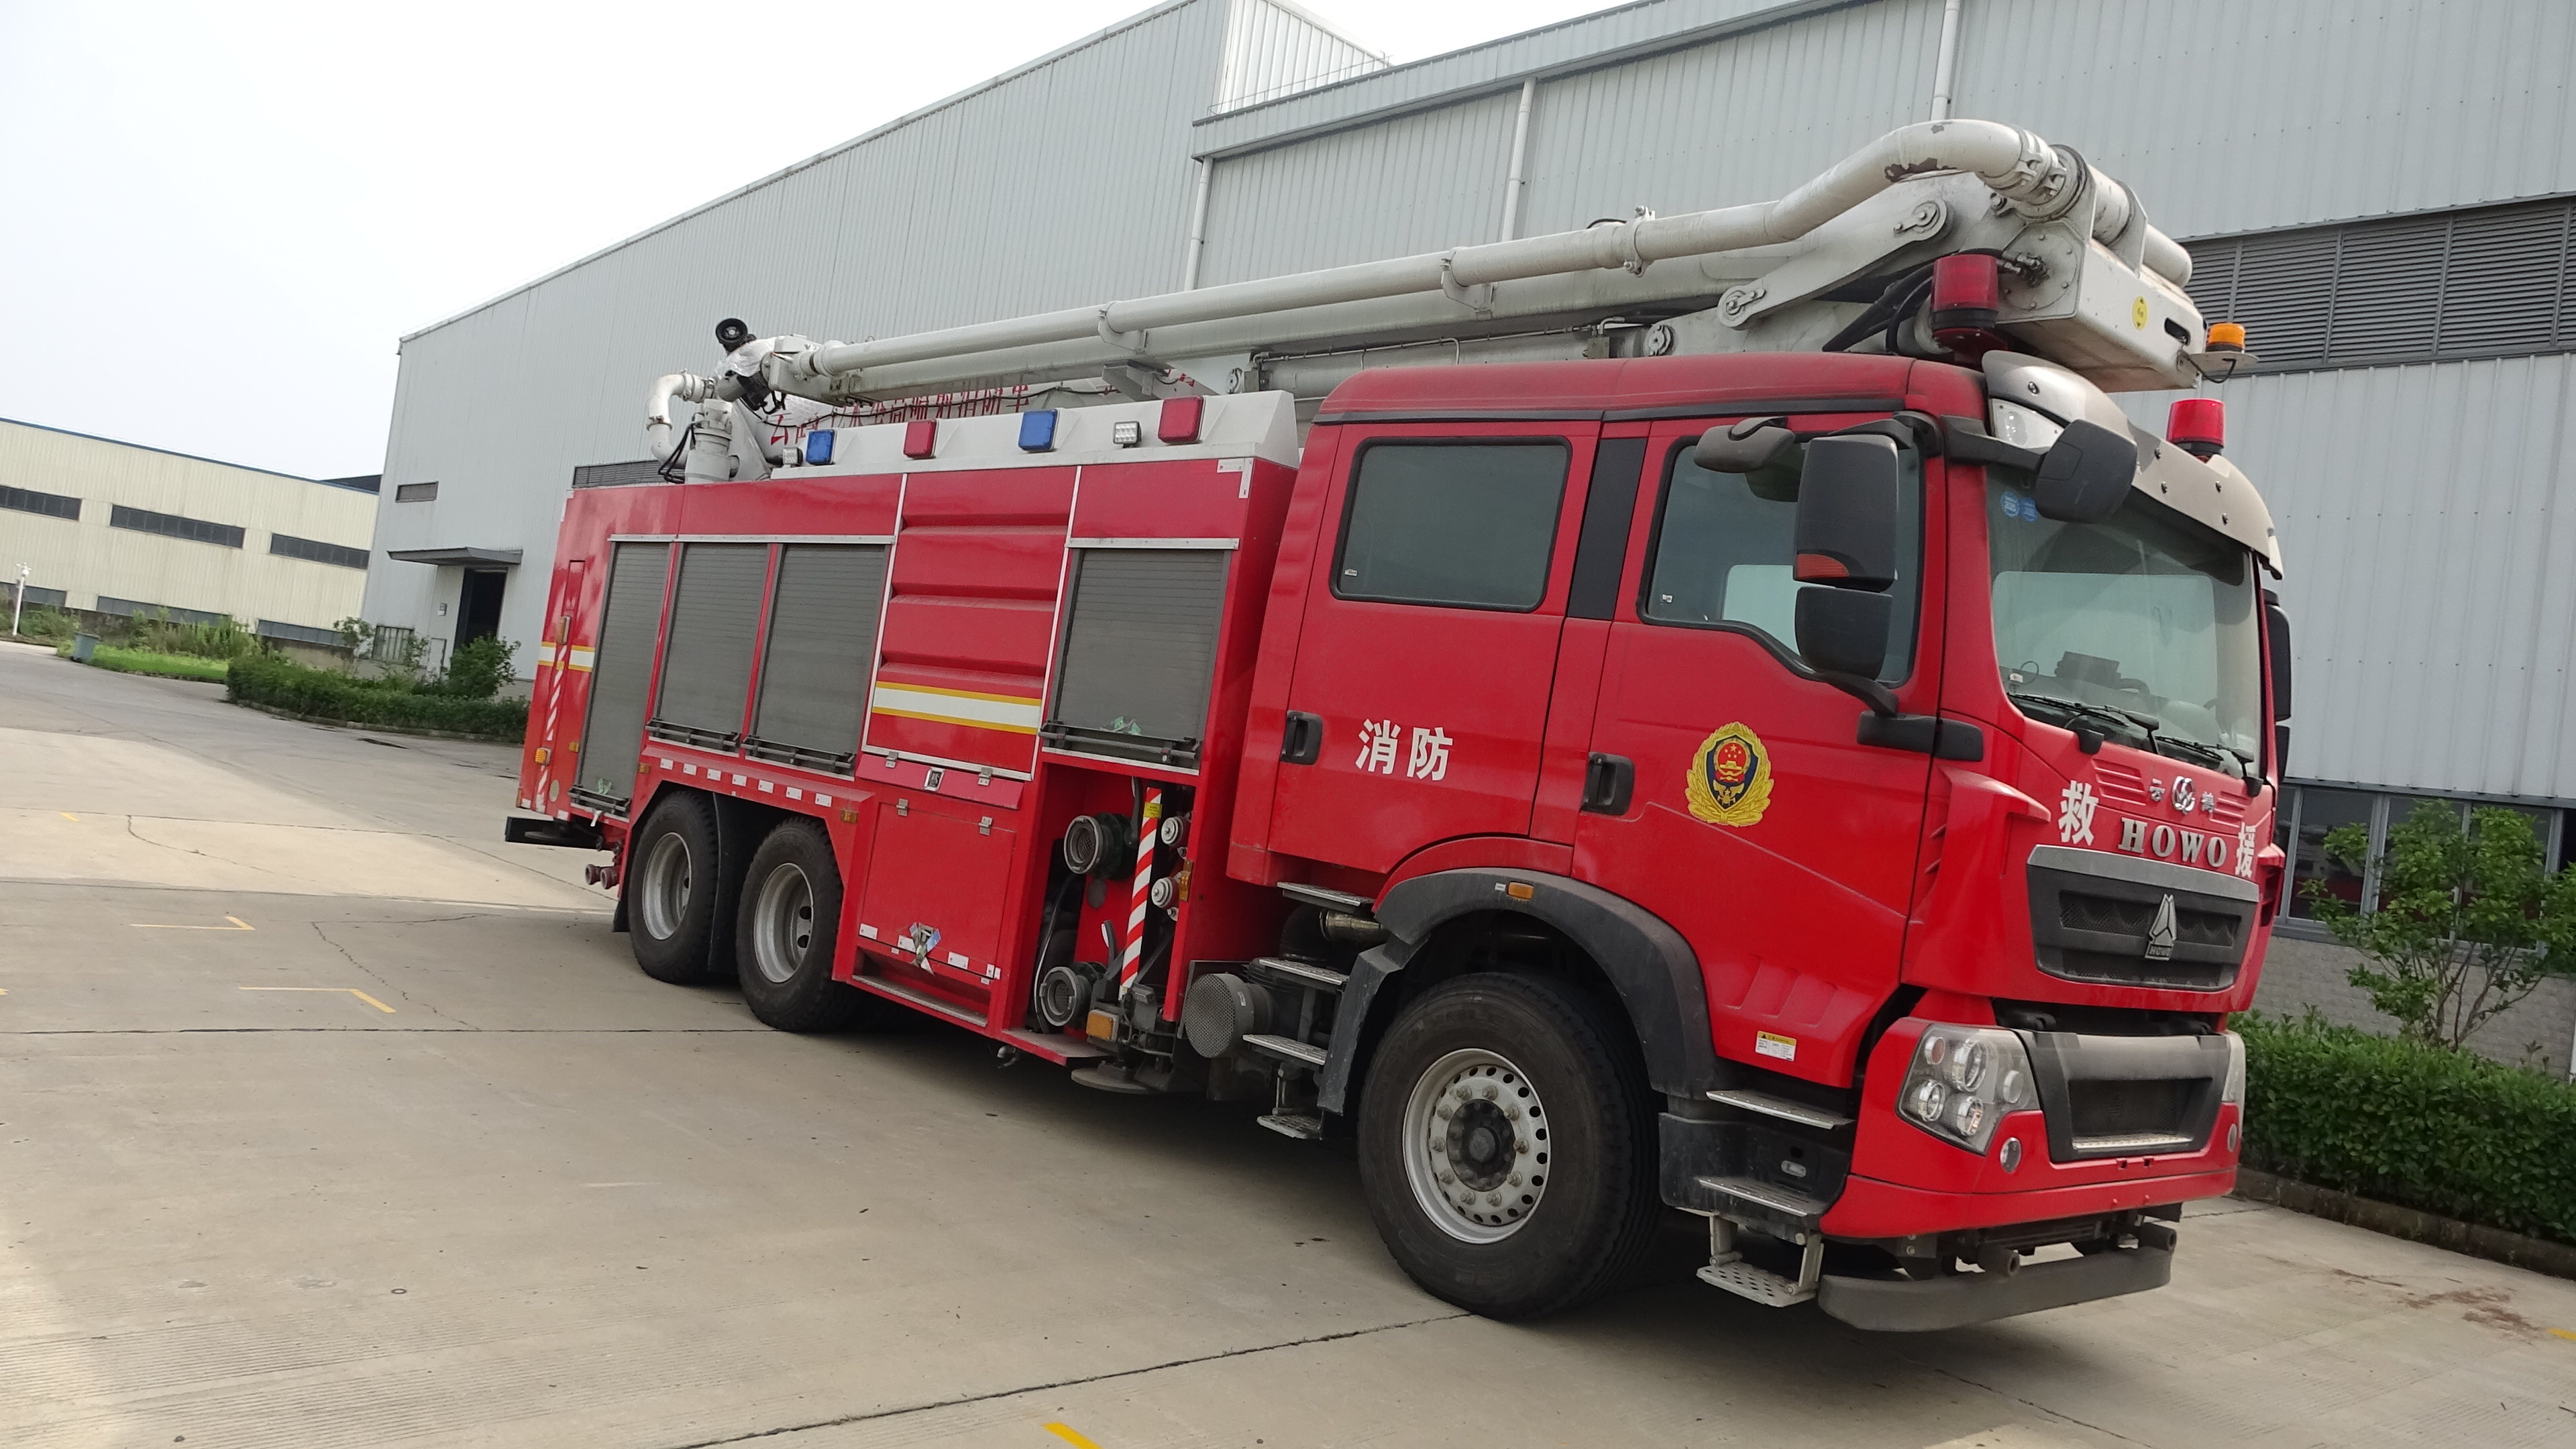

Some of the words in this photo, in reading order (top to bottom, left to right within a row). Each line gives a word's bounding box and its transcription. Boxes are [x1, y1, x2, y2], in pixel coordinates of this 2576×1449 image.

[1355, 718, 1453, 781] 消防
[2058, 780, 2099, 846] 救
[2235, 821, 2256, 878] 援
[2117, 817, 2227, 867] HOWO
